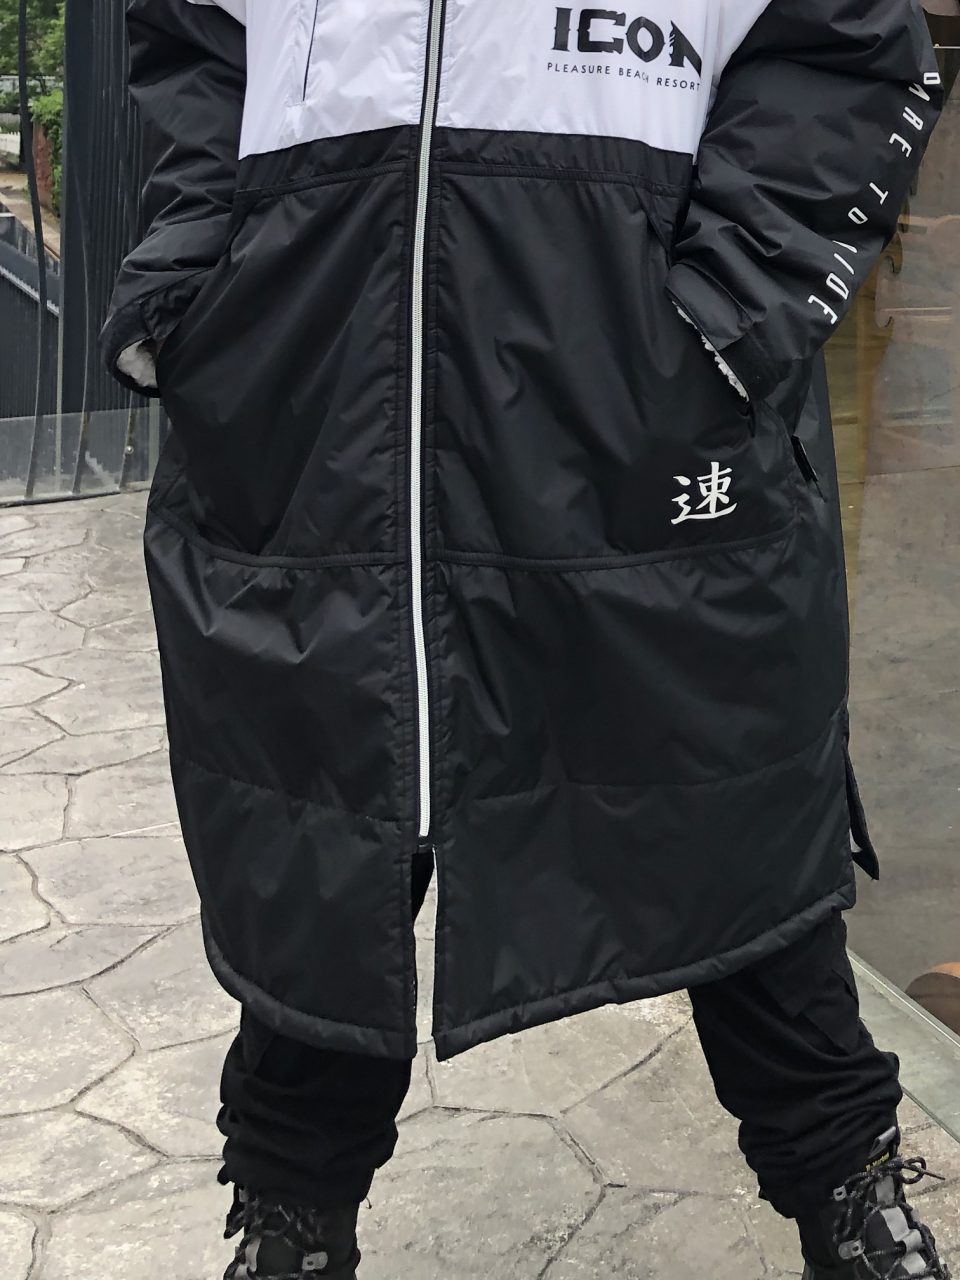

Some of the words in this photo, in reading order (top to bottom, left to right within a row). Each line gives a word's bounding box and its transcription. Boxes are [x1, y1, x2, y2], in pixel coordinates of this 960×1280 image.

[547, 62, 611, 75] PLEASURE
[888, 71, 941, 157] DARE
[847, 181, 889, 225] TO
[670, 461, 738, 525] 速
